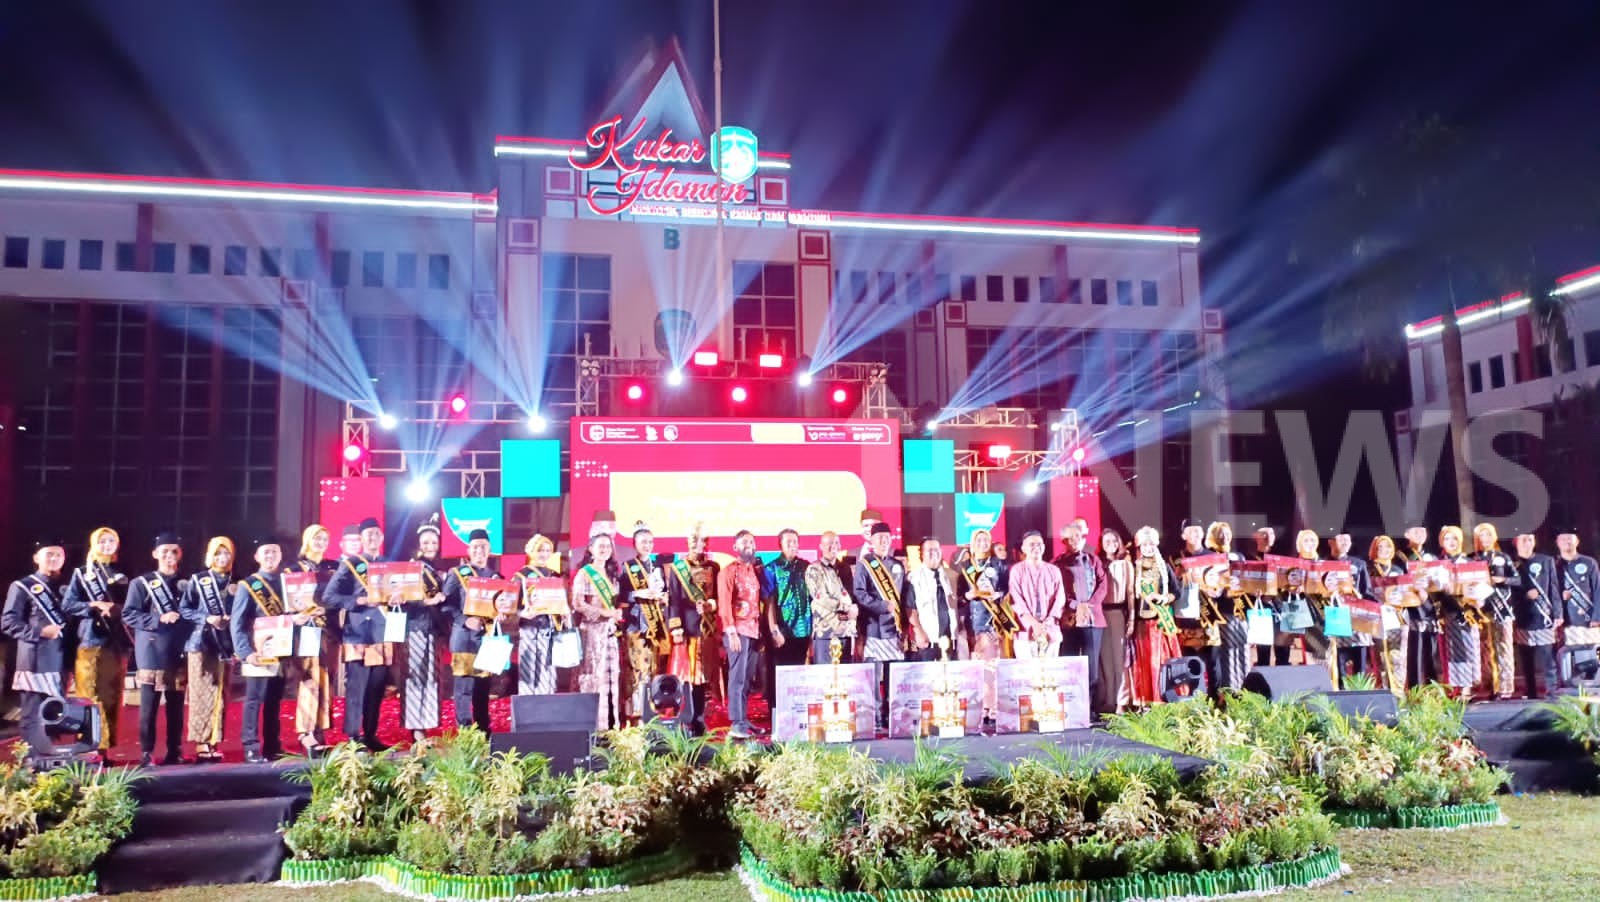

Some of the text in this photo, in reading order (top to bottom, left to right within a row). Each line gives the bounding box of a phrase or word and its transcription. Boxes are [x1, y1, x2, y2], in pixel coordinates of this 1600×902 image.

[567, 114, 706, 173] Kukar
[586, 163, 750, 216] Idaman
[663, 225, 681, 250] B
